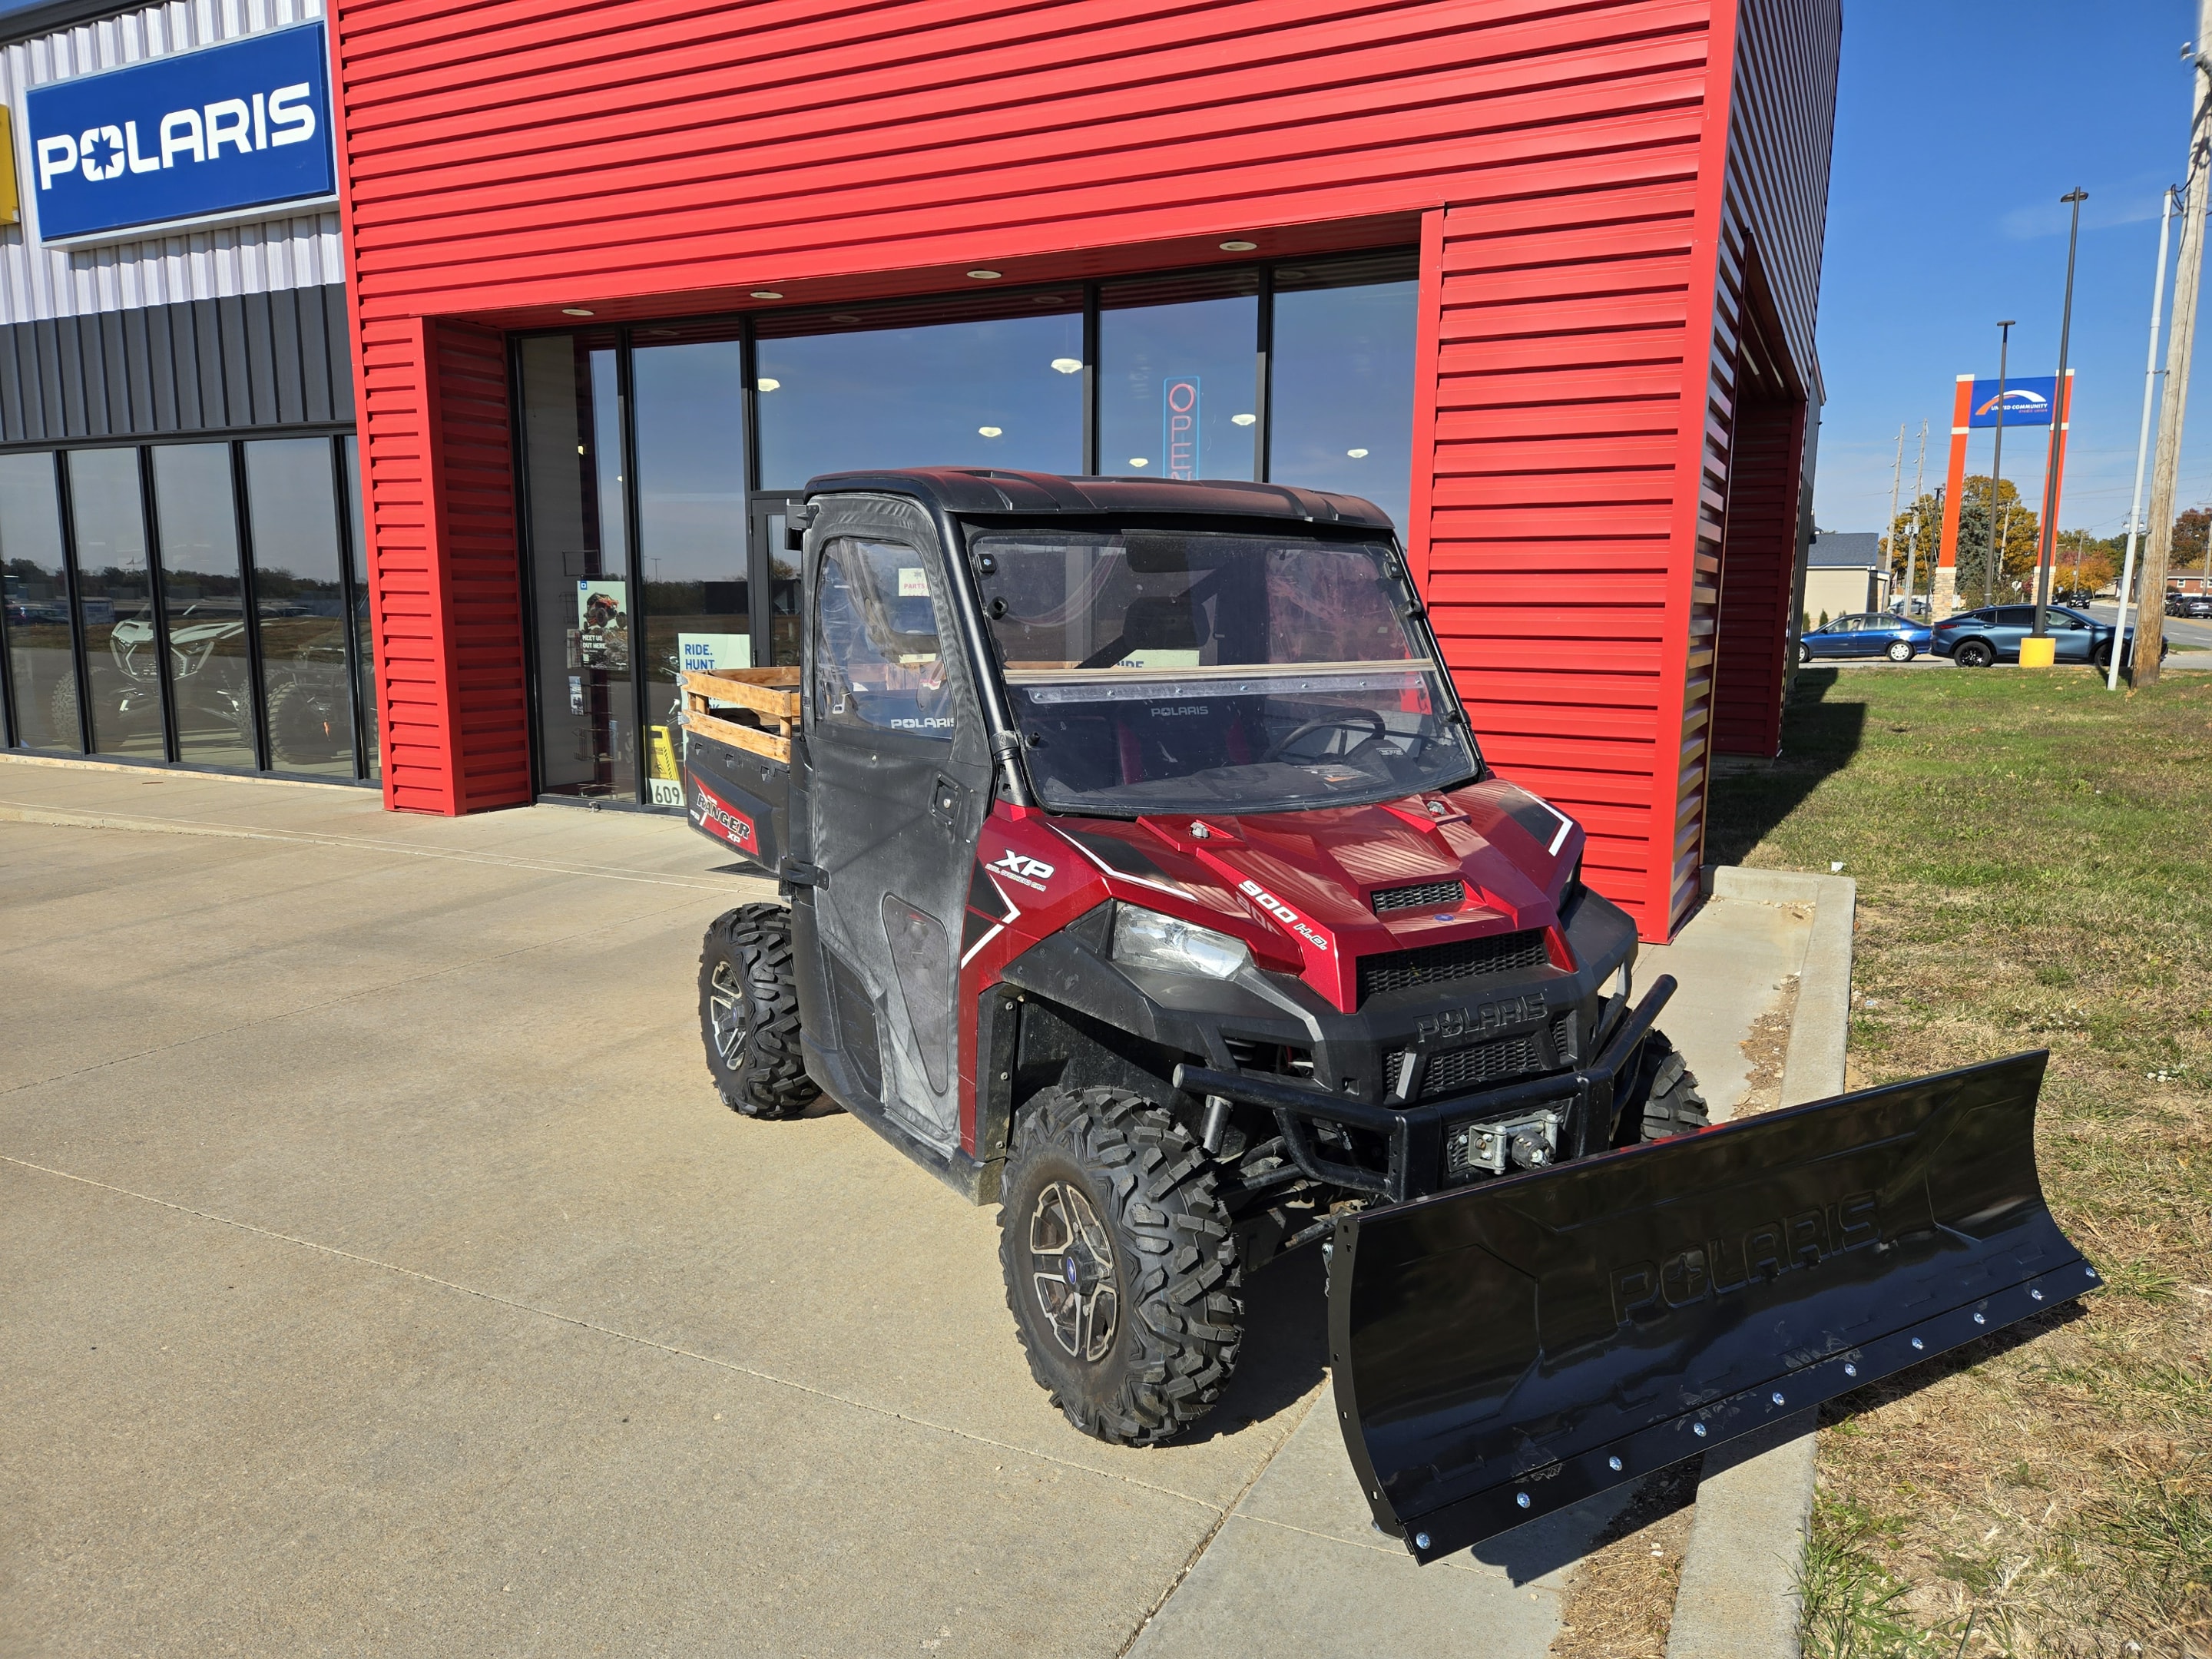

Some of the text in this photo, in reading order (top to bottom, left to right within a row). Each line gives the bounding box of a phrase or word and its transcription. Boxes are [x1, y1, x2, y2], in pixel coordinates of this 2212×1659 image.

[38, 82, 316, 190] POLARIS
[684, 644, 713, 656] RIDE.
[685, 659, 717, 670] HUNT.
[1151, 706, 1209, 717] POLARIS
[655, 785, 680, 805] 609
[697, 793, 750, 839] RANGER
[727, 831, 741, 843] XP
[993, 849, 1055, 879] XP
[1238, 879, 1327, 951] 900 H.O.
[1413, 992, 1548, 1044] POLARIS
[1610, 1190, 1883, 1329] POLARIS
